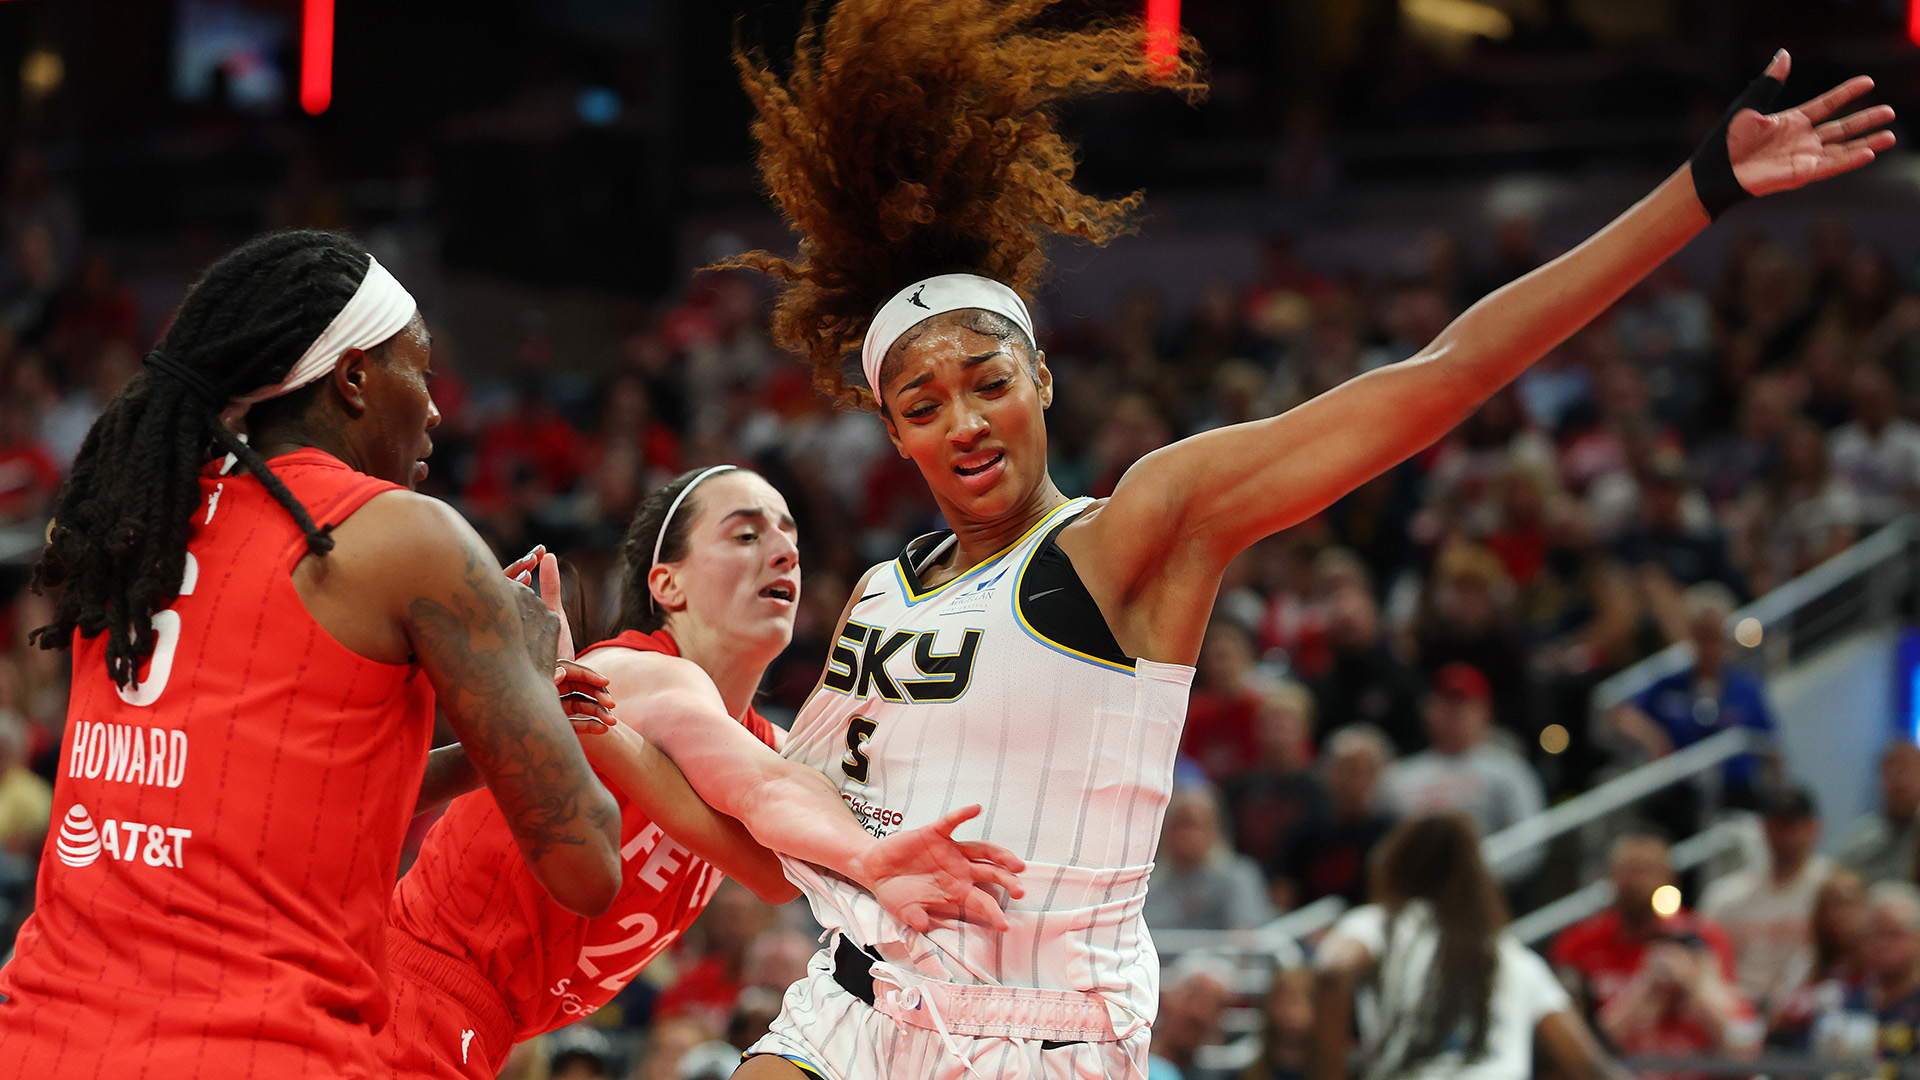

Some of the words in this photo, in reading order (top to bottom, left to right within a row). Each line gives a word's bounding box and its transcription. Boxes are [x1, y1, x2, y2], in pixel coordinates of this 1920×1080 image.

[822, 618, 986, 705] SKY
[69, 721, 188, 788] HOWARD
[101, 819, 192, 868] AT&T
[577, 912, 680, 991] 22
